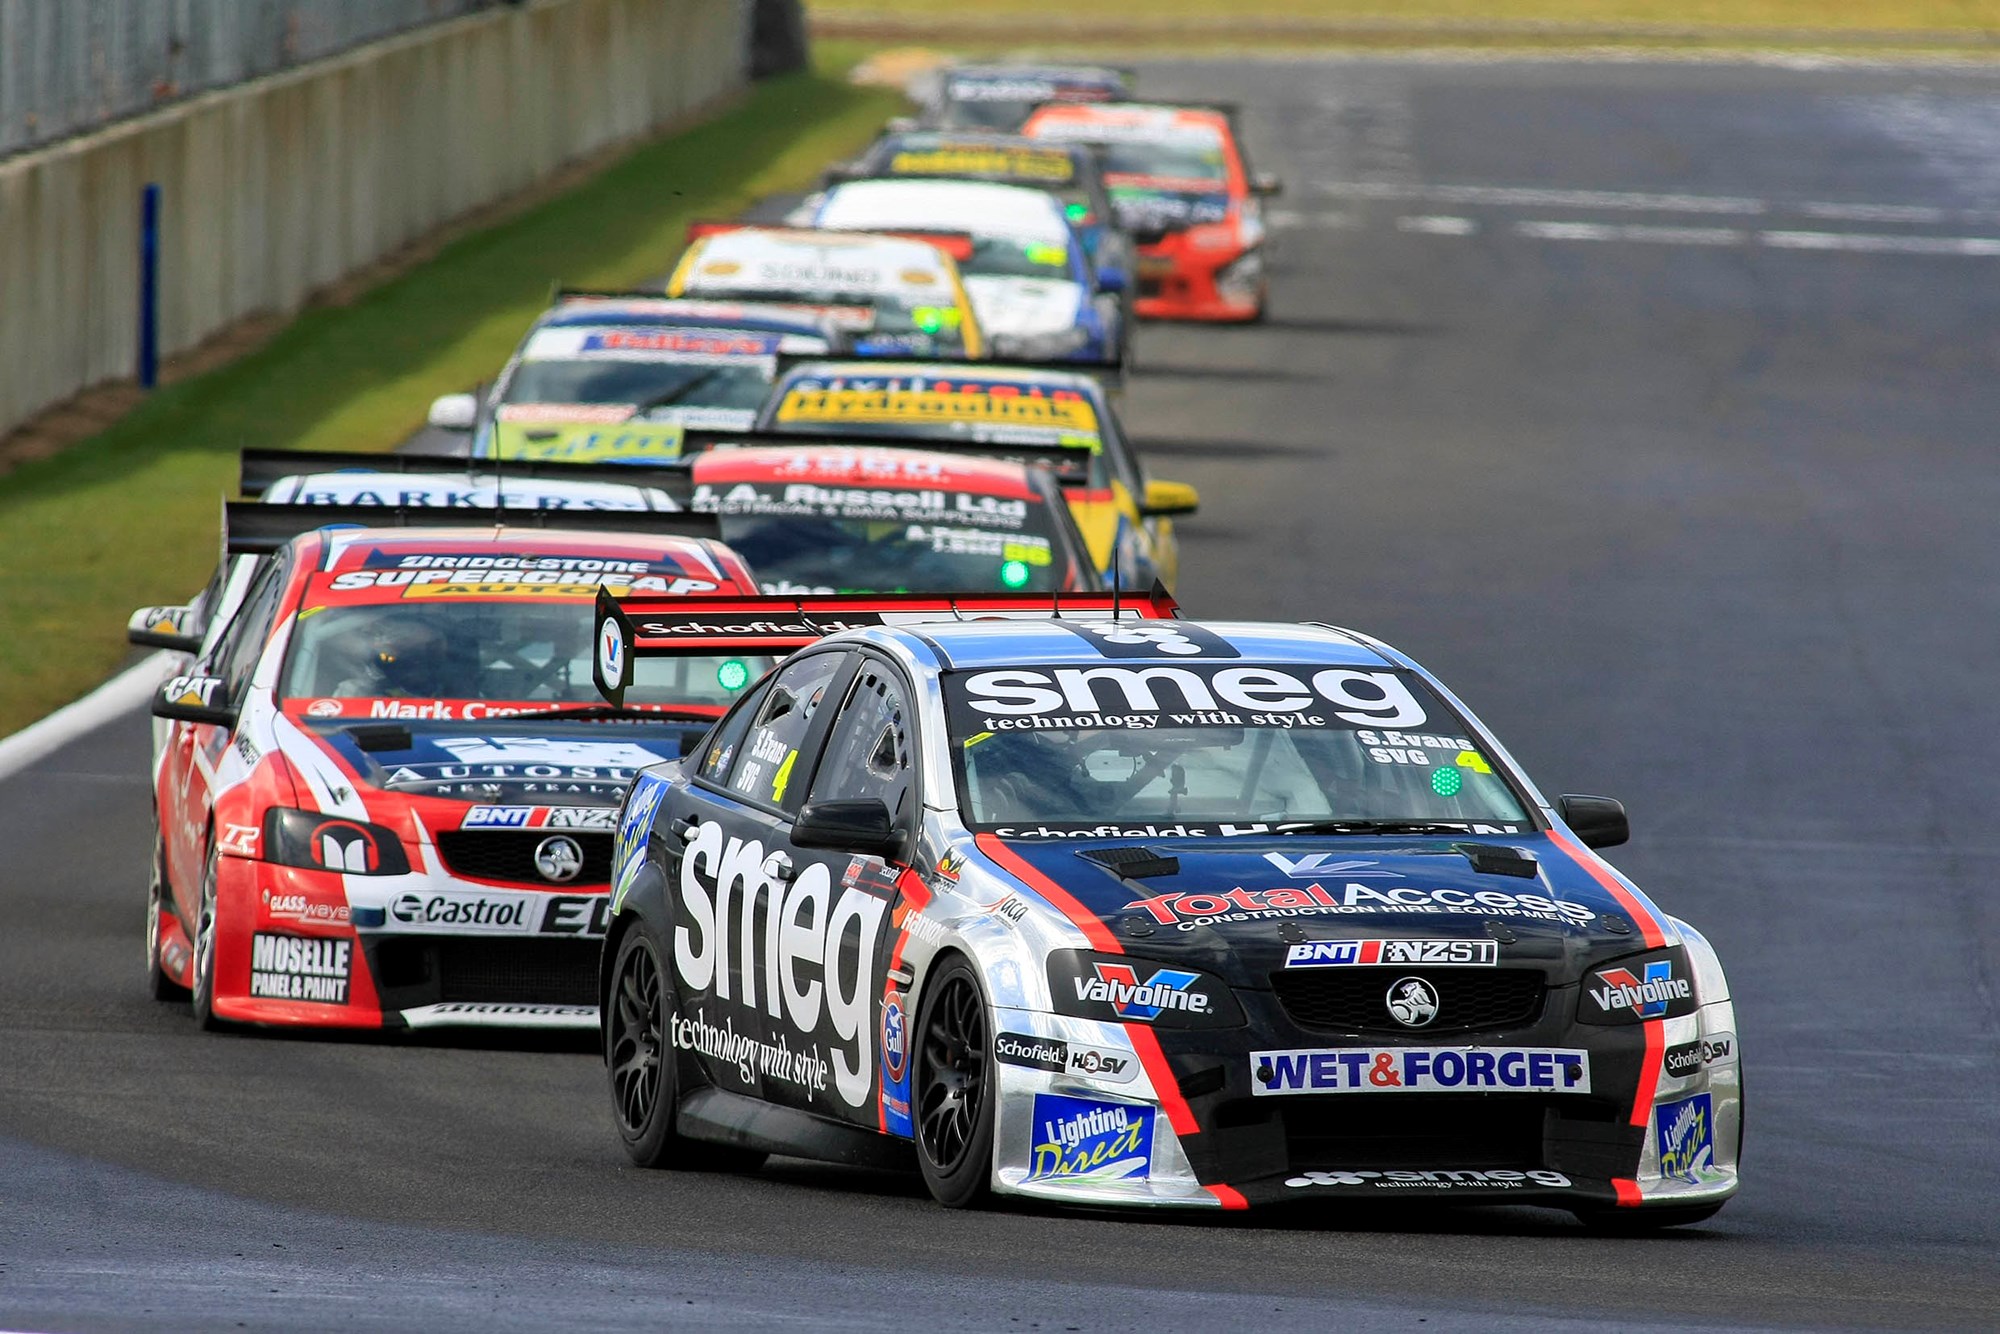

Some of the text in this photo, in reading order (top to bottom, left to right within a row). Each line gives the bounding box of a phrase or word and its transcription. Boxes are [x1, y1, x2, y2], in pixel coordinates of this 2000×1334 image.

[784, 484, 944, 510] Russell
[956, 493, 1026, 517] Ltd
[398, 554, 650, 574] BRIDGESTONE
[329, 568, 720, 597] SUPERCHEAP
[434, 584, 604, 597] AUTO
[642, 620, 866, 635] Schofieds
[165, 676, 222, 706] CAT
[964, 667, 1427, 728] smeg
[370, 699, 453, 720] Mark
[983, 710, 1326, 731] technology with style
[752, 727, 788, 766] S.Evans
[1358, 729, 1475, 751] S.Evans
[1368, 747, 1430, 766] SVG
[1454, 750, 1492, 774] 4
[437, 784, 501, 794] NEW
[736, 759, 762, 794] SVG
[772, 748, 799, 802] 4
[466, 809, 529, 827] BNT
[426, 897, 526, 926] Castrol
[1001, 898, 1029, 923] aca
[1177, 904, 1588, 932] CONSTRUCTION HIRE EQUIPMENT
[254, 934, 350, 976] MOSELLE
[674, 820, 888, 1107] smeg
[1291, 941, 1494, 963] BNT NZST
[1073, 976, 1209, 1014] Valvoline
[1589, 977, 1691, 1012] Valvoline
[670, 1007, 829, 1103] technology with style
[885, 1027, 903, 1055] Gull
[1045, 1106, 1128, 1148] Lighting
[1664, 1100, 1696, 1152] Lighting
[1034, 1116, 1143, 1179] Direct
[1374, 1179, 1523, 1189] technology with style
[1382, 1169, 1572, 1187] smeg
